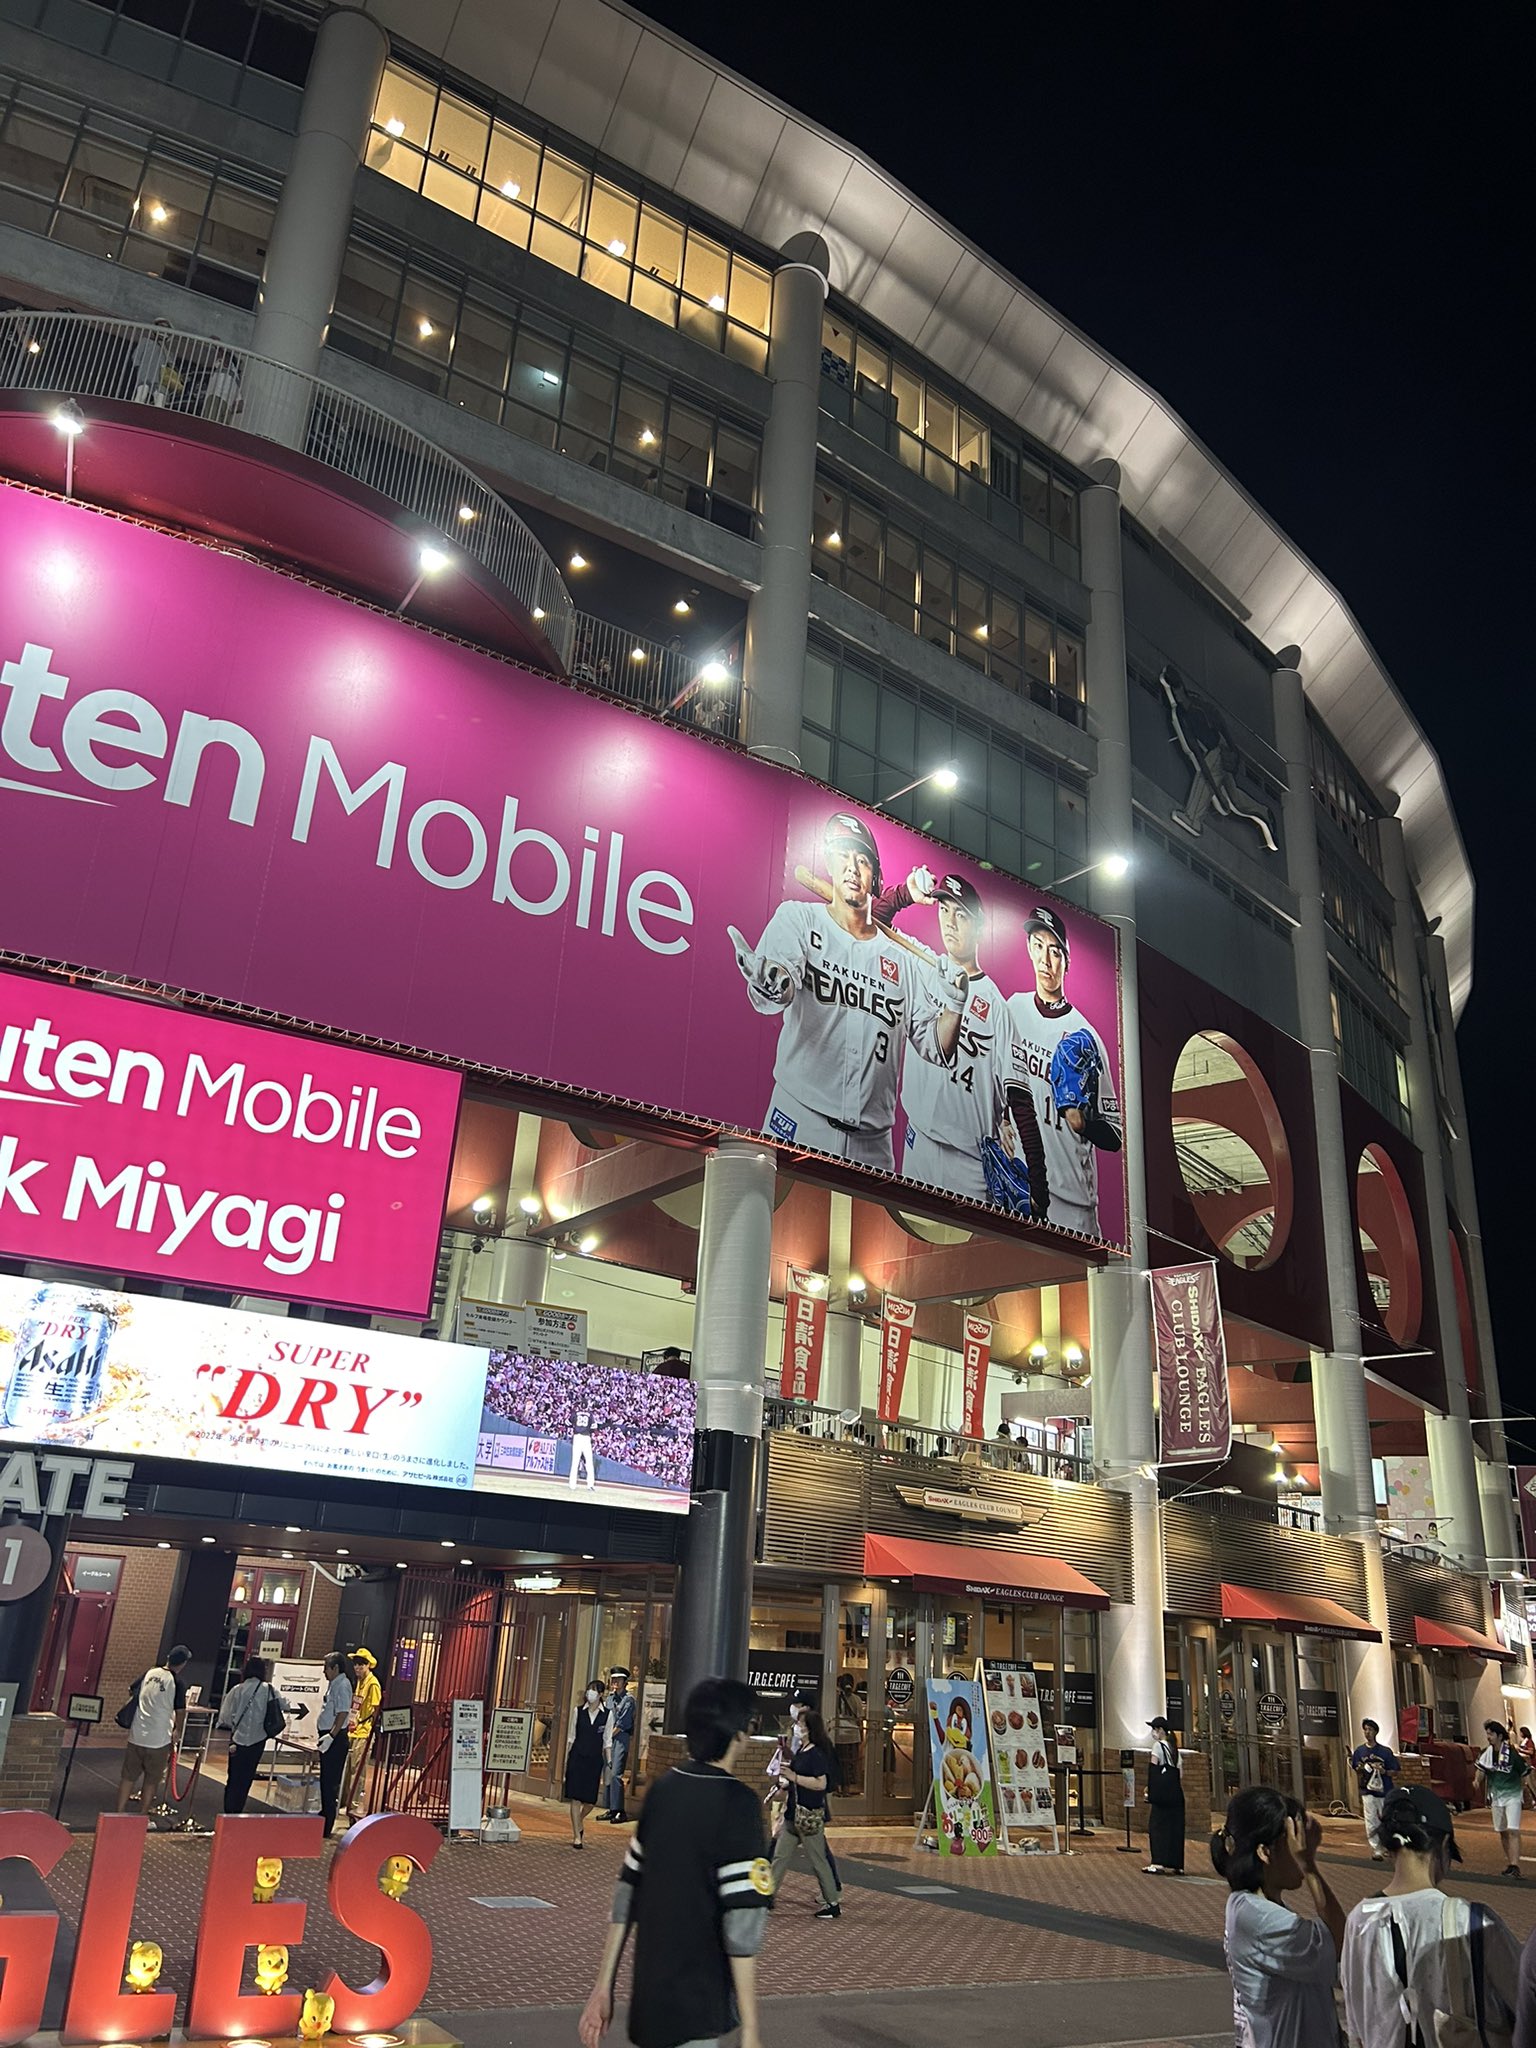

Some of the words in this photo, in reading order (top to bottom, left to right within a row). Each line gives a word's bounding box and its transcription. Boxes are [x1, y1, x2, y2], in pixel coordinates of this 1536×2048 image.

[0, 642, 265, 827] ten
[292, 735, 694, 955] Mobile
[810, 930, 822, 950] C
[803, 961, 905, 1028] EAGLES
[822, 959, 885, 992] RAKUTEN
[875, 1030, 889, 1062] 3
[1022, 1038, 1052, 1059] AKUTE
[177, 1054, 422, 1159] Mobile
[773, 1110, 795, 1132] FUJI
[62, 1156, 345, 1275] Miyagi
[1171, 1299, 1186, 1349] CLUB
[1187, 1285, 1205, 1350] SHIDAX
[19, 1339, 103, 1379] Asahi
[268, 1340, 371, 1374] SUPER
[44, 1382, 64, 1397] 生
[1174, 1351, 1192, 1433] LOUNGE
[1195, 1367, 1211, 1443] EAGLES
[953, 1499, 978, 1509] EAGLES
[979, 1502, 994, 1512] CLUB
[996, 1506, 1019, 1515] LOUNGE
[3, 1539, 23, 1585] 1
[965, 1584, 990, 1594] SHIDAX
[995, 1587, 1022, 1598] EAGLES
[1021, 1590, 1039, 1600] CLUB
[1039, 1592, 1065, 1603] LOUNGE
